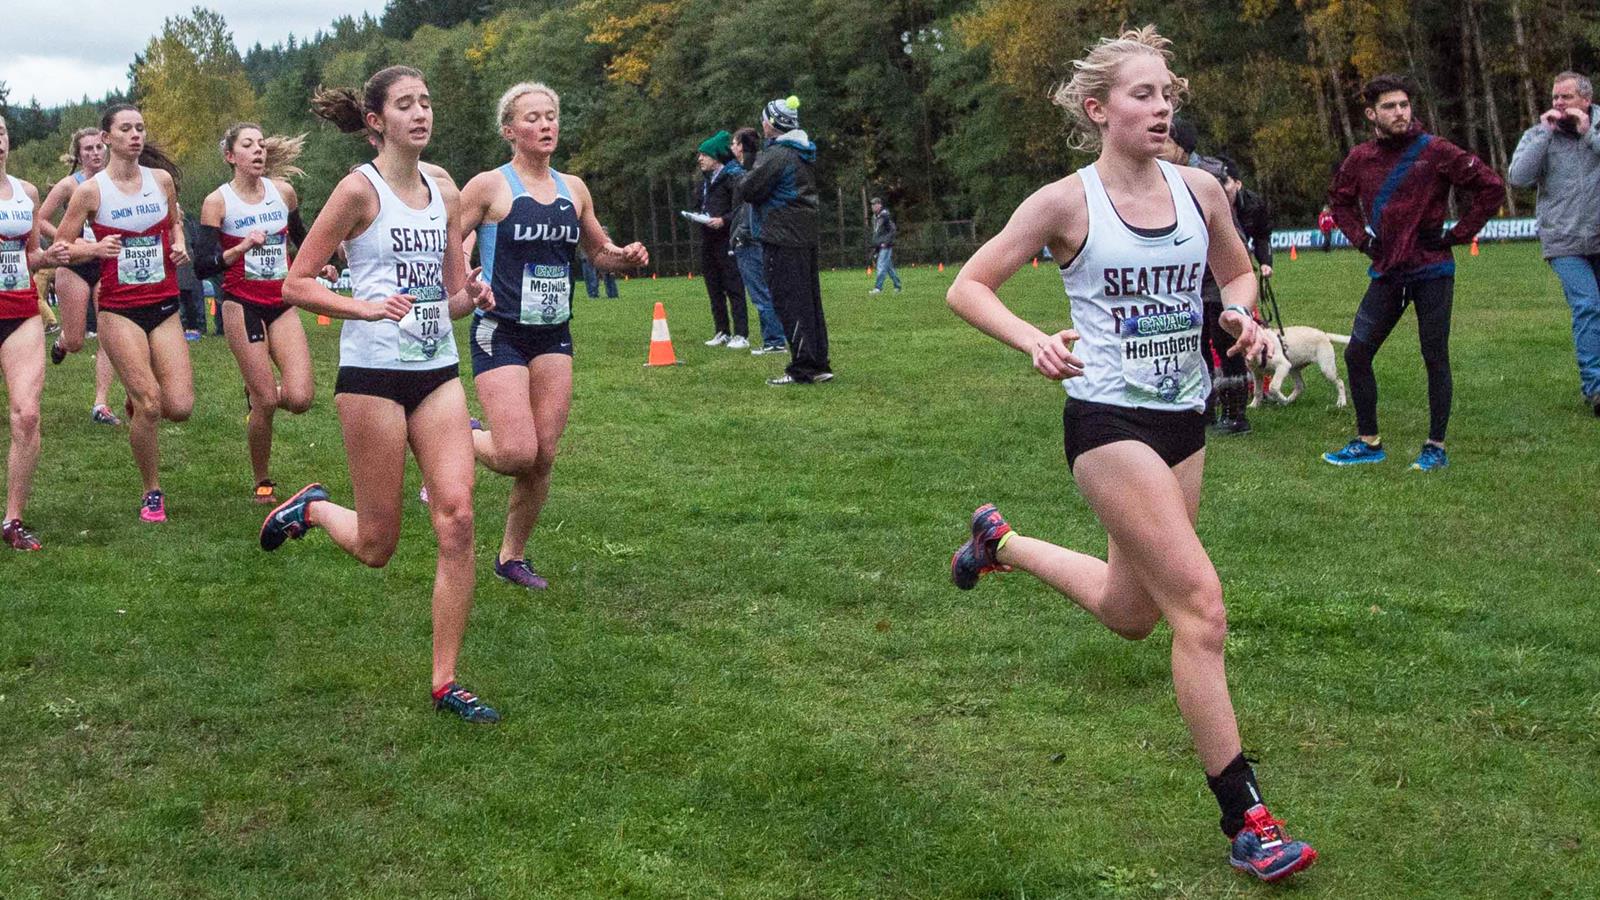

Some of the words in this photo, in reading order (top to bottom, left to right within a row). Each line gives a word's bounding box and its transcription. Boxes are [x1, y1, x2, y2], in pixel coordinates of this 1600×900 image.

[111, 207, 133, 220] SIMON
[136, 203, 161, 215] FRASER
[234, 215, 256, 229] SIMON
[259, 210, 283, 223] FRASER
[125, 248, 157, 259] Bassett
[2, 264, 18, 274] 203
[134, 259, 150, 268] 193
[260, 257, 276, 266] 199
[1104, 262, 1200, 297] SEATTLE
[414, 305, 440, 320] Foote
[421, 321, 439, 335] 170
[1126, 334, 1199, 359] Holmberg
[1153, 356, 1181, 375] 171
